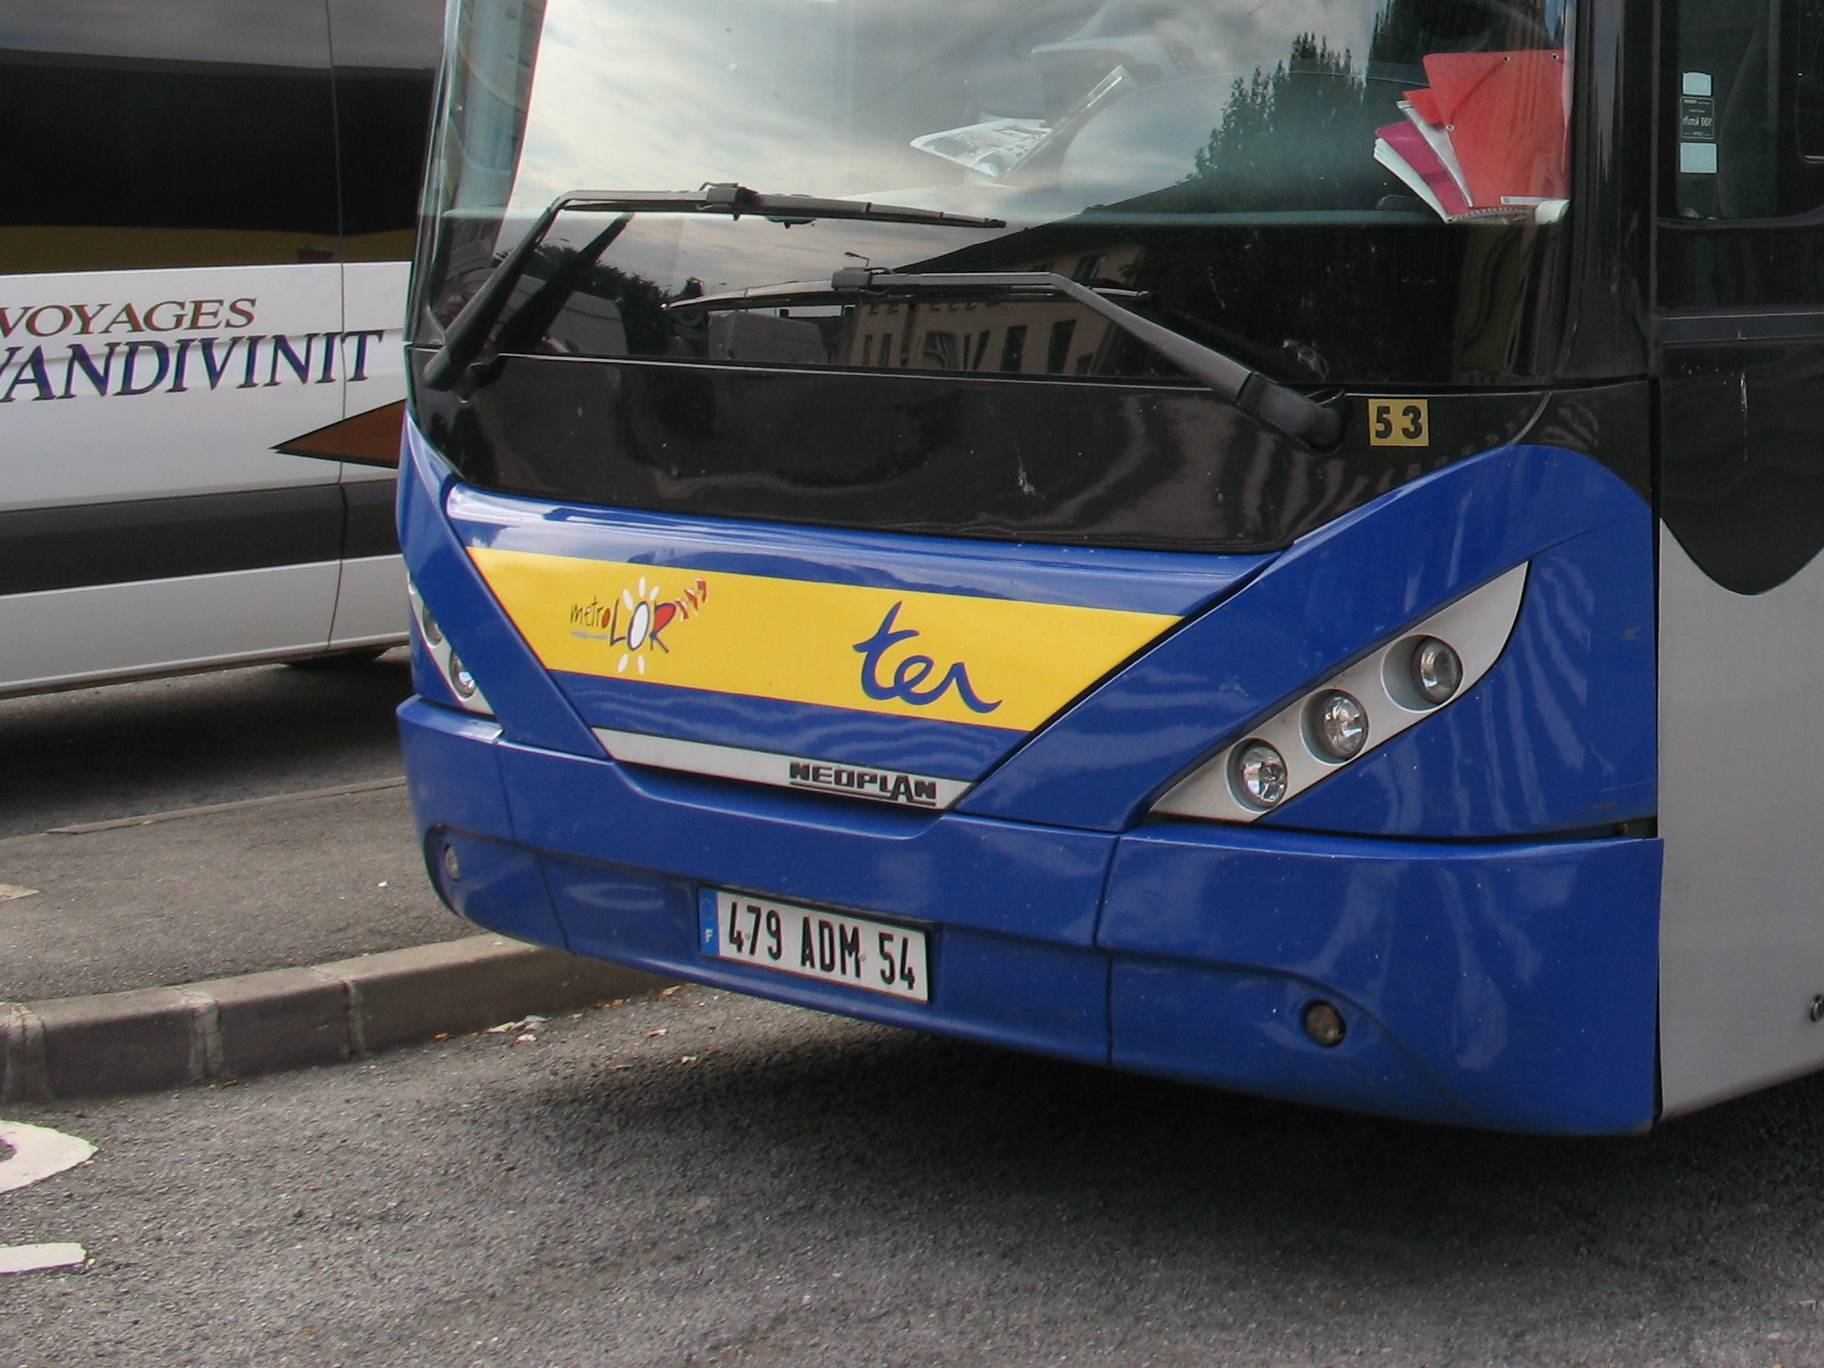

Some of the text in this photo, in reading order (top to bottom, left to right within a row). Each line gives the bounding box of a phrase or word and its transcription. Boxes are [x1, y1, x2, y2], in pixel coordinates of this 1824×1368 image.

[0, 297, 258, 337] VOYAGES
[1374, 405, 1424, 440] 53
[851, 600, 1003, 714] ter
[789, 762, 937, 807] NEOPLAN
[705, 929, 713, 943] F
[728, 901, 916, 990] 479 ADM 54
